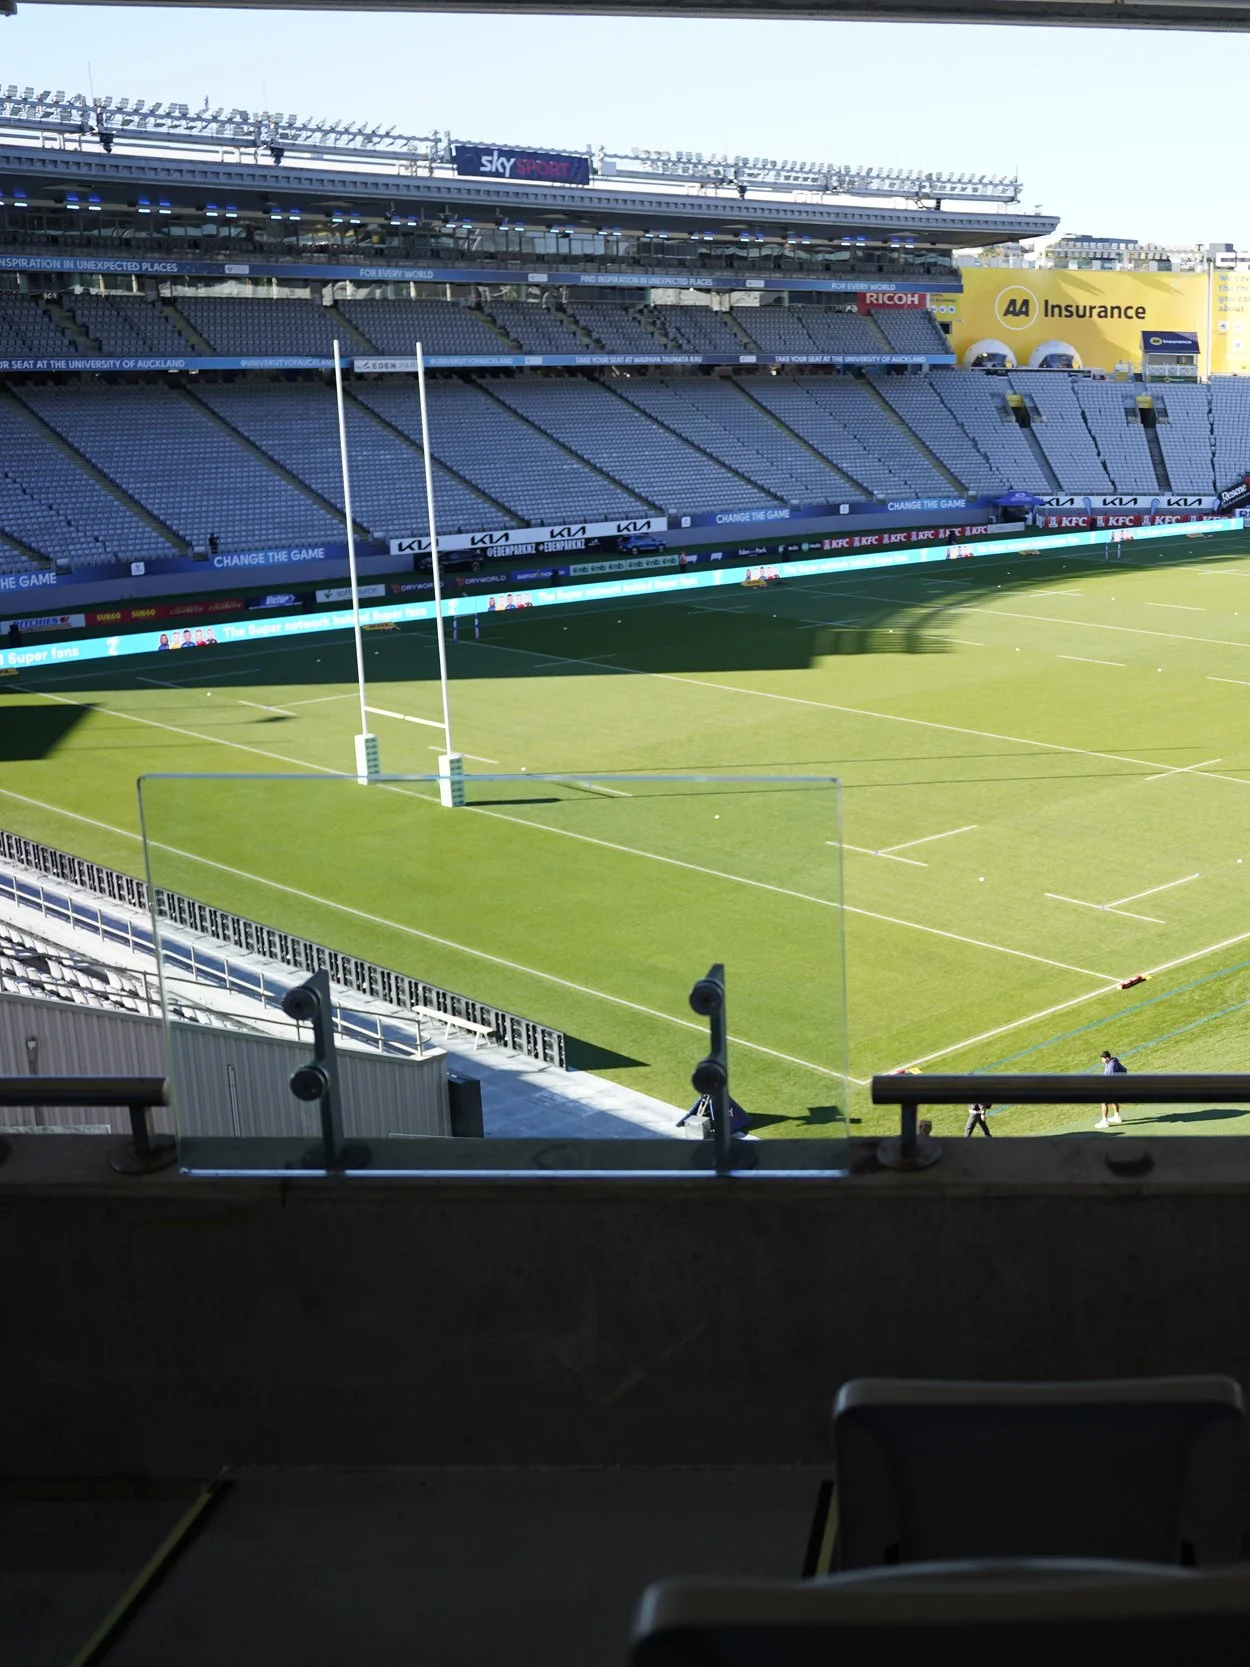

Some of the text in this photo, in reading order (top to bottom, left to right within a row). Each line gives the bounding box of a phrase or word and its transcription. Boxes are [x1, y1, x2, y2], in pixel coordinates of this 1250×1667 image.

[480, 151, 570, 177] sky SPORT
[63, 259, 74, 269] IN
[76, 260, 140, 271] UNEXPECTED
[141, 262, 178, 272] PLACES
[360, 269, 434, 279] FOR EVERY WORLD
[831, 282, 896, 291] FOR EVERY WORLD
[866, 293, 919, 305] RICOH
[1003, 299, 1146, 319] AA Insurance
[12, 359, 186, 369] SEAT AT THE UNIVERSITY OF AUCKLAND
[372, 361, 417, 370] EDEN PAR
[1221, 484, 1247, 503] Resene
[888, 499, 966, 511] CHANGE THE GAME
[1102, 497, 1138, 507] KIA
[1167, 497, 1202, 507] KIA
[716, 509, 790, 524] CHANGE THE GAME
[1061, 516, 1088, 527] KFC
[1108, 516, 1134, 526] KFC
[1154, 516, 1181, 525] KFC
[616, 520, 651, 533] KIA
[971, 526, 988, 535] KFC
[550, 526, 586, 539] KIA
[890, 533, 907, 543] KFC
[919, 531, 935, 540] KFC
[470, 532, 509, 546] KIA
[831, 538, 850, 548] KFC
[861, 535, 879, 545] KFC
[397, 539, 438, 552] KIA
[214, 548, 324, 568] CHANGE THE GAME
[19, 573, 57, 588] GAME
[465, 575, 506, 585] DRYWORLD
[336, 586, 377, 597] softource
[401, 581, 444, 591] DRYWORD
[223, 626, 246, 639] The
[248, 622, 281, 637] Super
[285, 617, 330, 632] network
[372, 606, 404, 621] Super
[8, 646, 80, 665] Super fans
